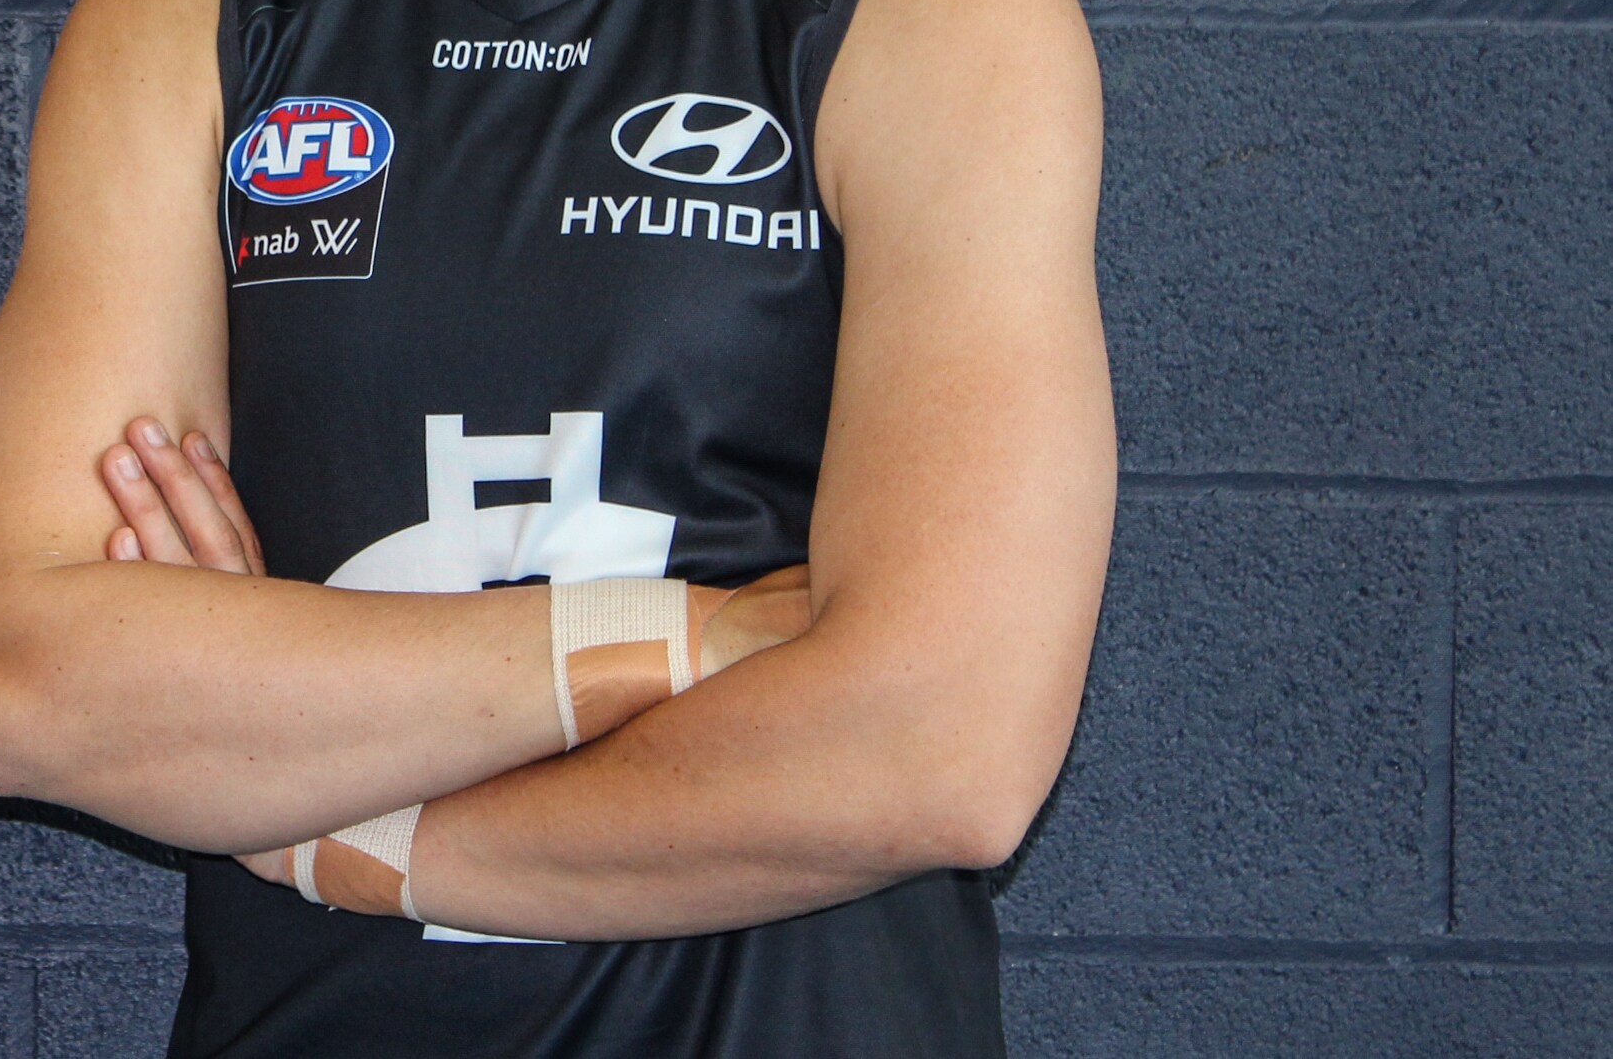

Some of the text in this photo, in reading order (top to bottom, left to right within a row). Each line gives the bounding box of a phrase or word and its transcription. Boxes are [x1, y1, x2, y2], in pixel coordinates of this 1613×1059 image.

[433, 37, 592, 72] COTTON:ON
[244, 121, 372, 181] AFL
[253, 228, 299, 257] nab
[561, 196, 820, 250] HYUNDAI
